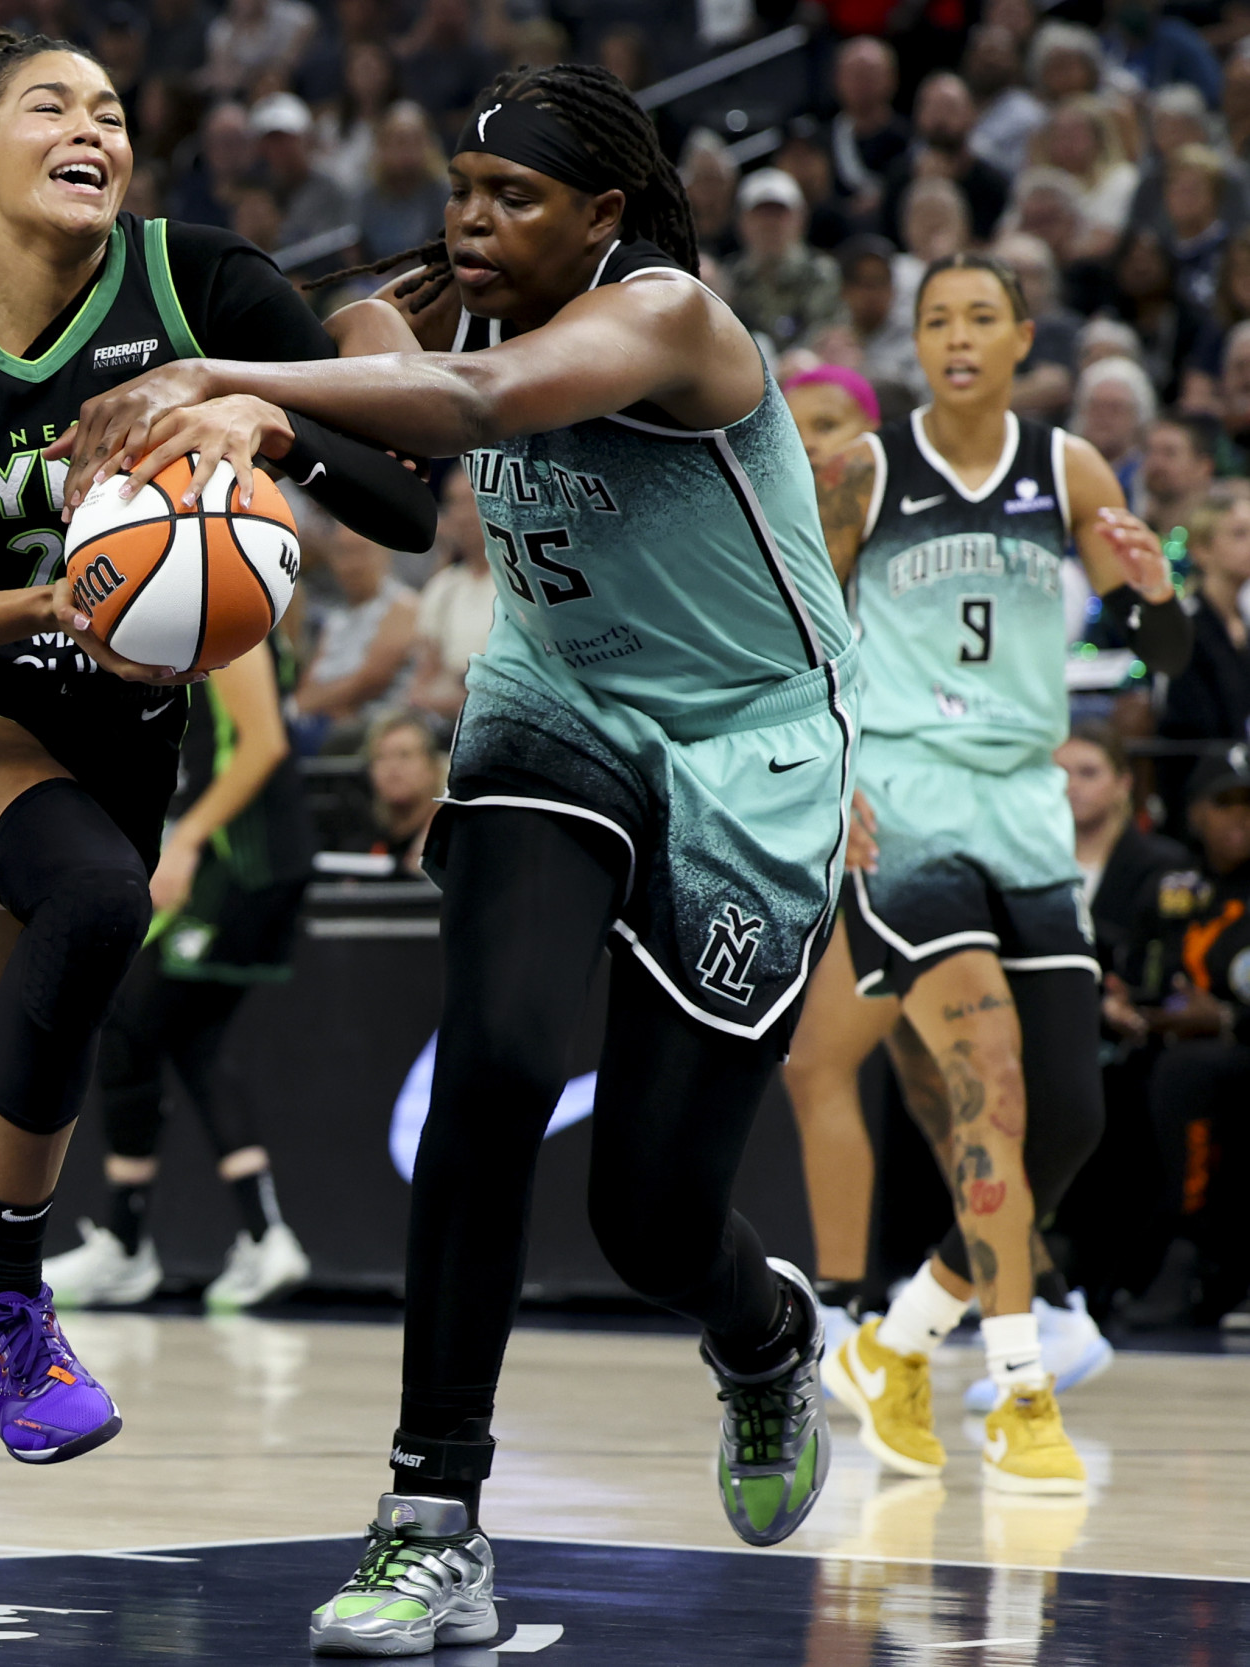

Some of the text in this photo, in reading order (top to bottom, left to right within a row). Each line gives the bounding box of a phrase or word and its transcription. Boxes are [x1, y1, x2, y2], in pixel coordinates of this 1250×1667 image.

[93, 338, 159, 361] FEDERATED
[6, 528, 66, 589] 2
[484, 518, 595, 608] 35
[554, 623, 631, 655] Liberty
[562, 633, 643, 669] Mutual
[958, 595, 996, 666] 9
